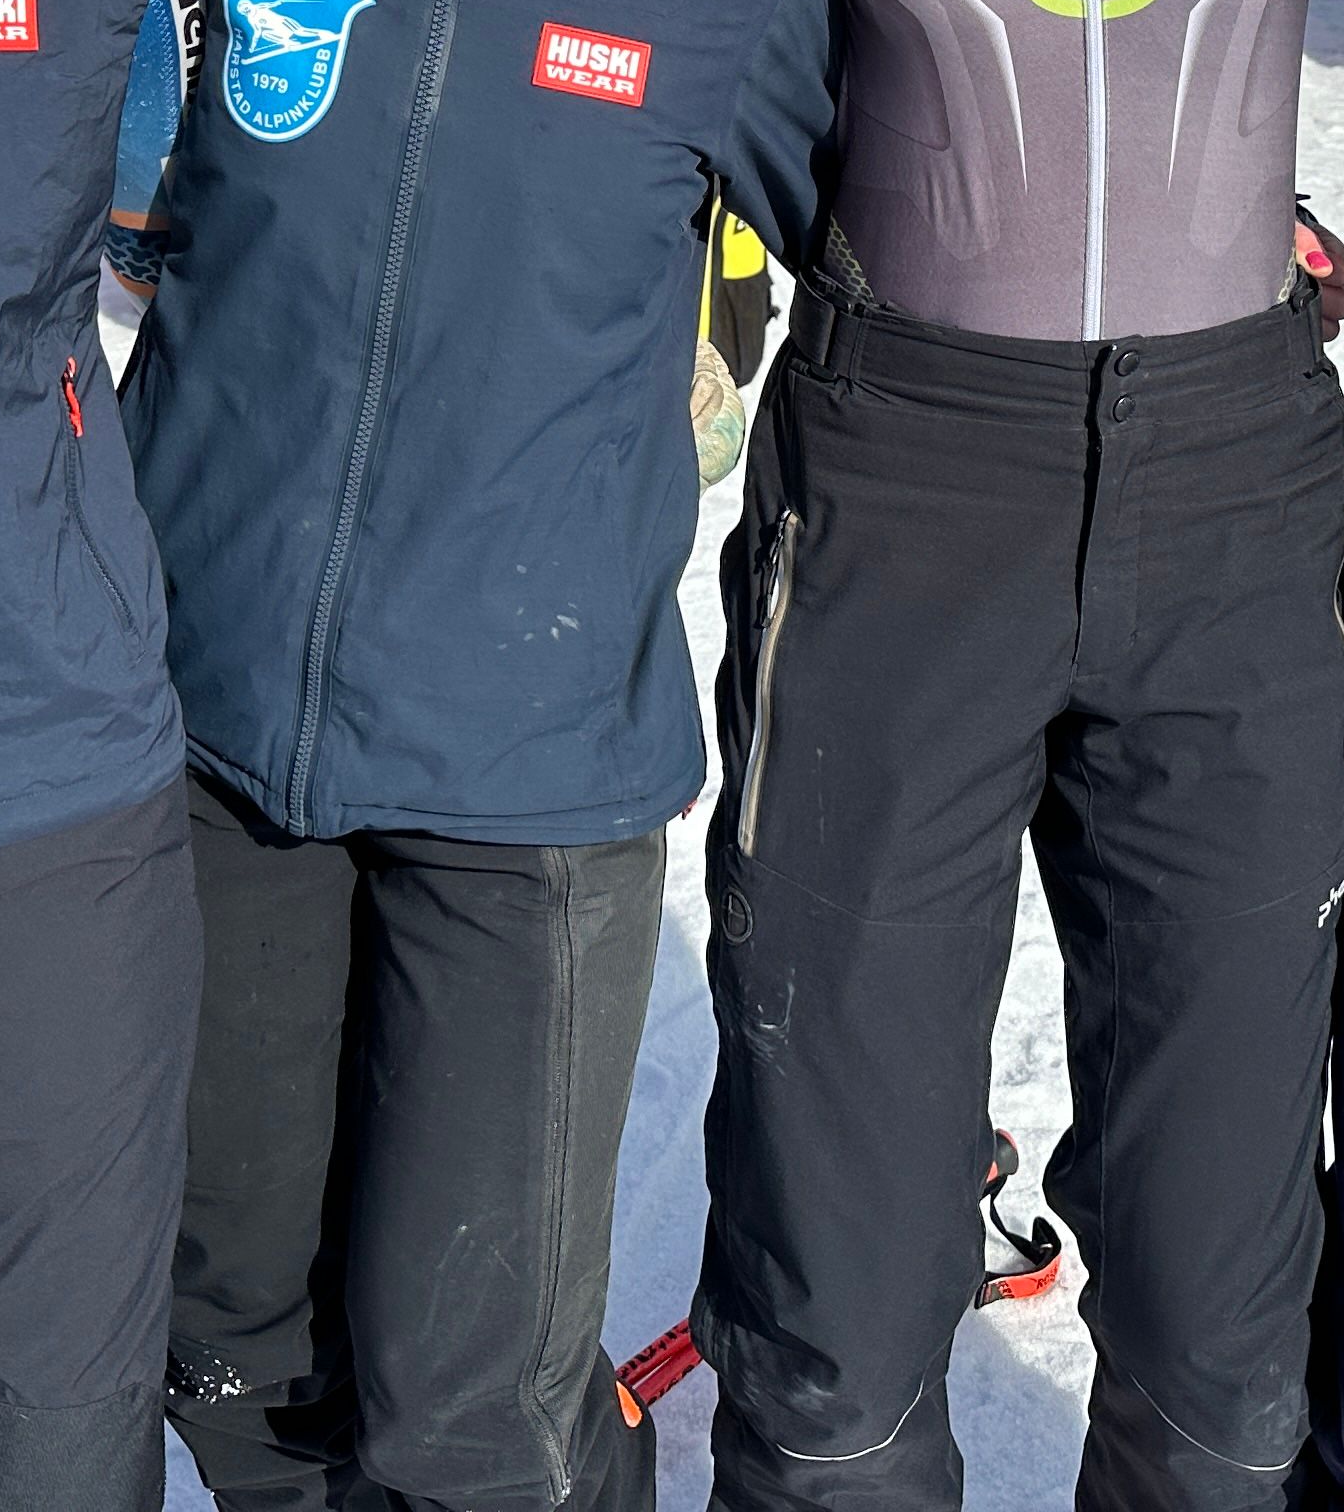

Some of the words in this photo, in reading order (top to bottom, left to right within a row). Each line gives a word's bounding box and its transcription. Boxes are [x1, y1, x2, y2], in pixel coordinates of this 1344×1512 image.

[548, 34, 641, 79] HUSKI
[233, 26, 253, 116] HARSTAD
[252, 48, 331, 129] ALPINKLUBB
[251, 71, 289, 95] 1979
[545, 63, 636, 96] WEAR
